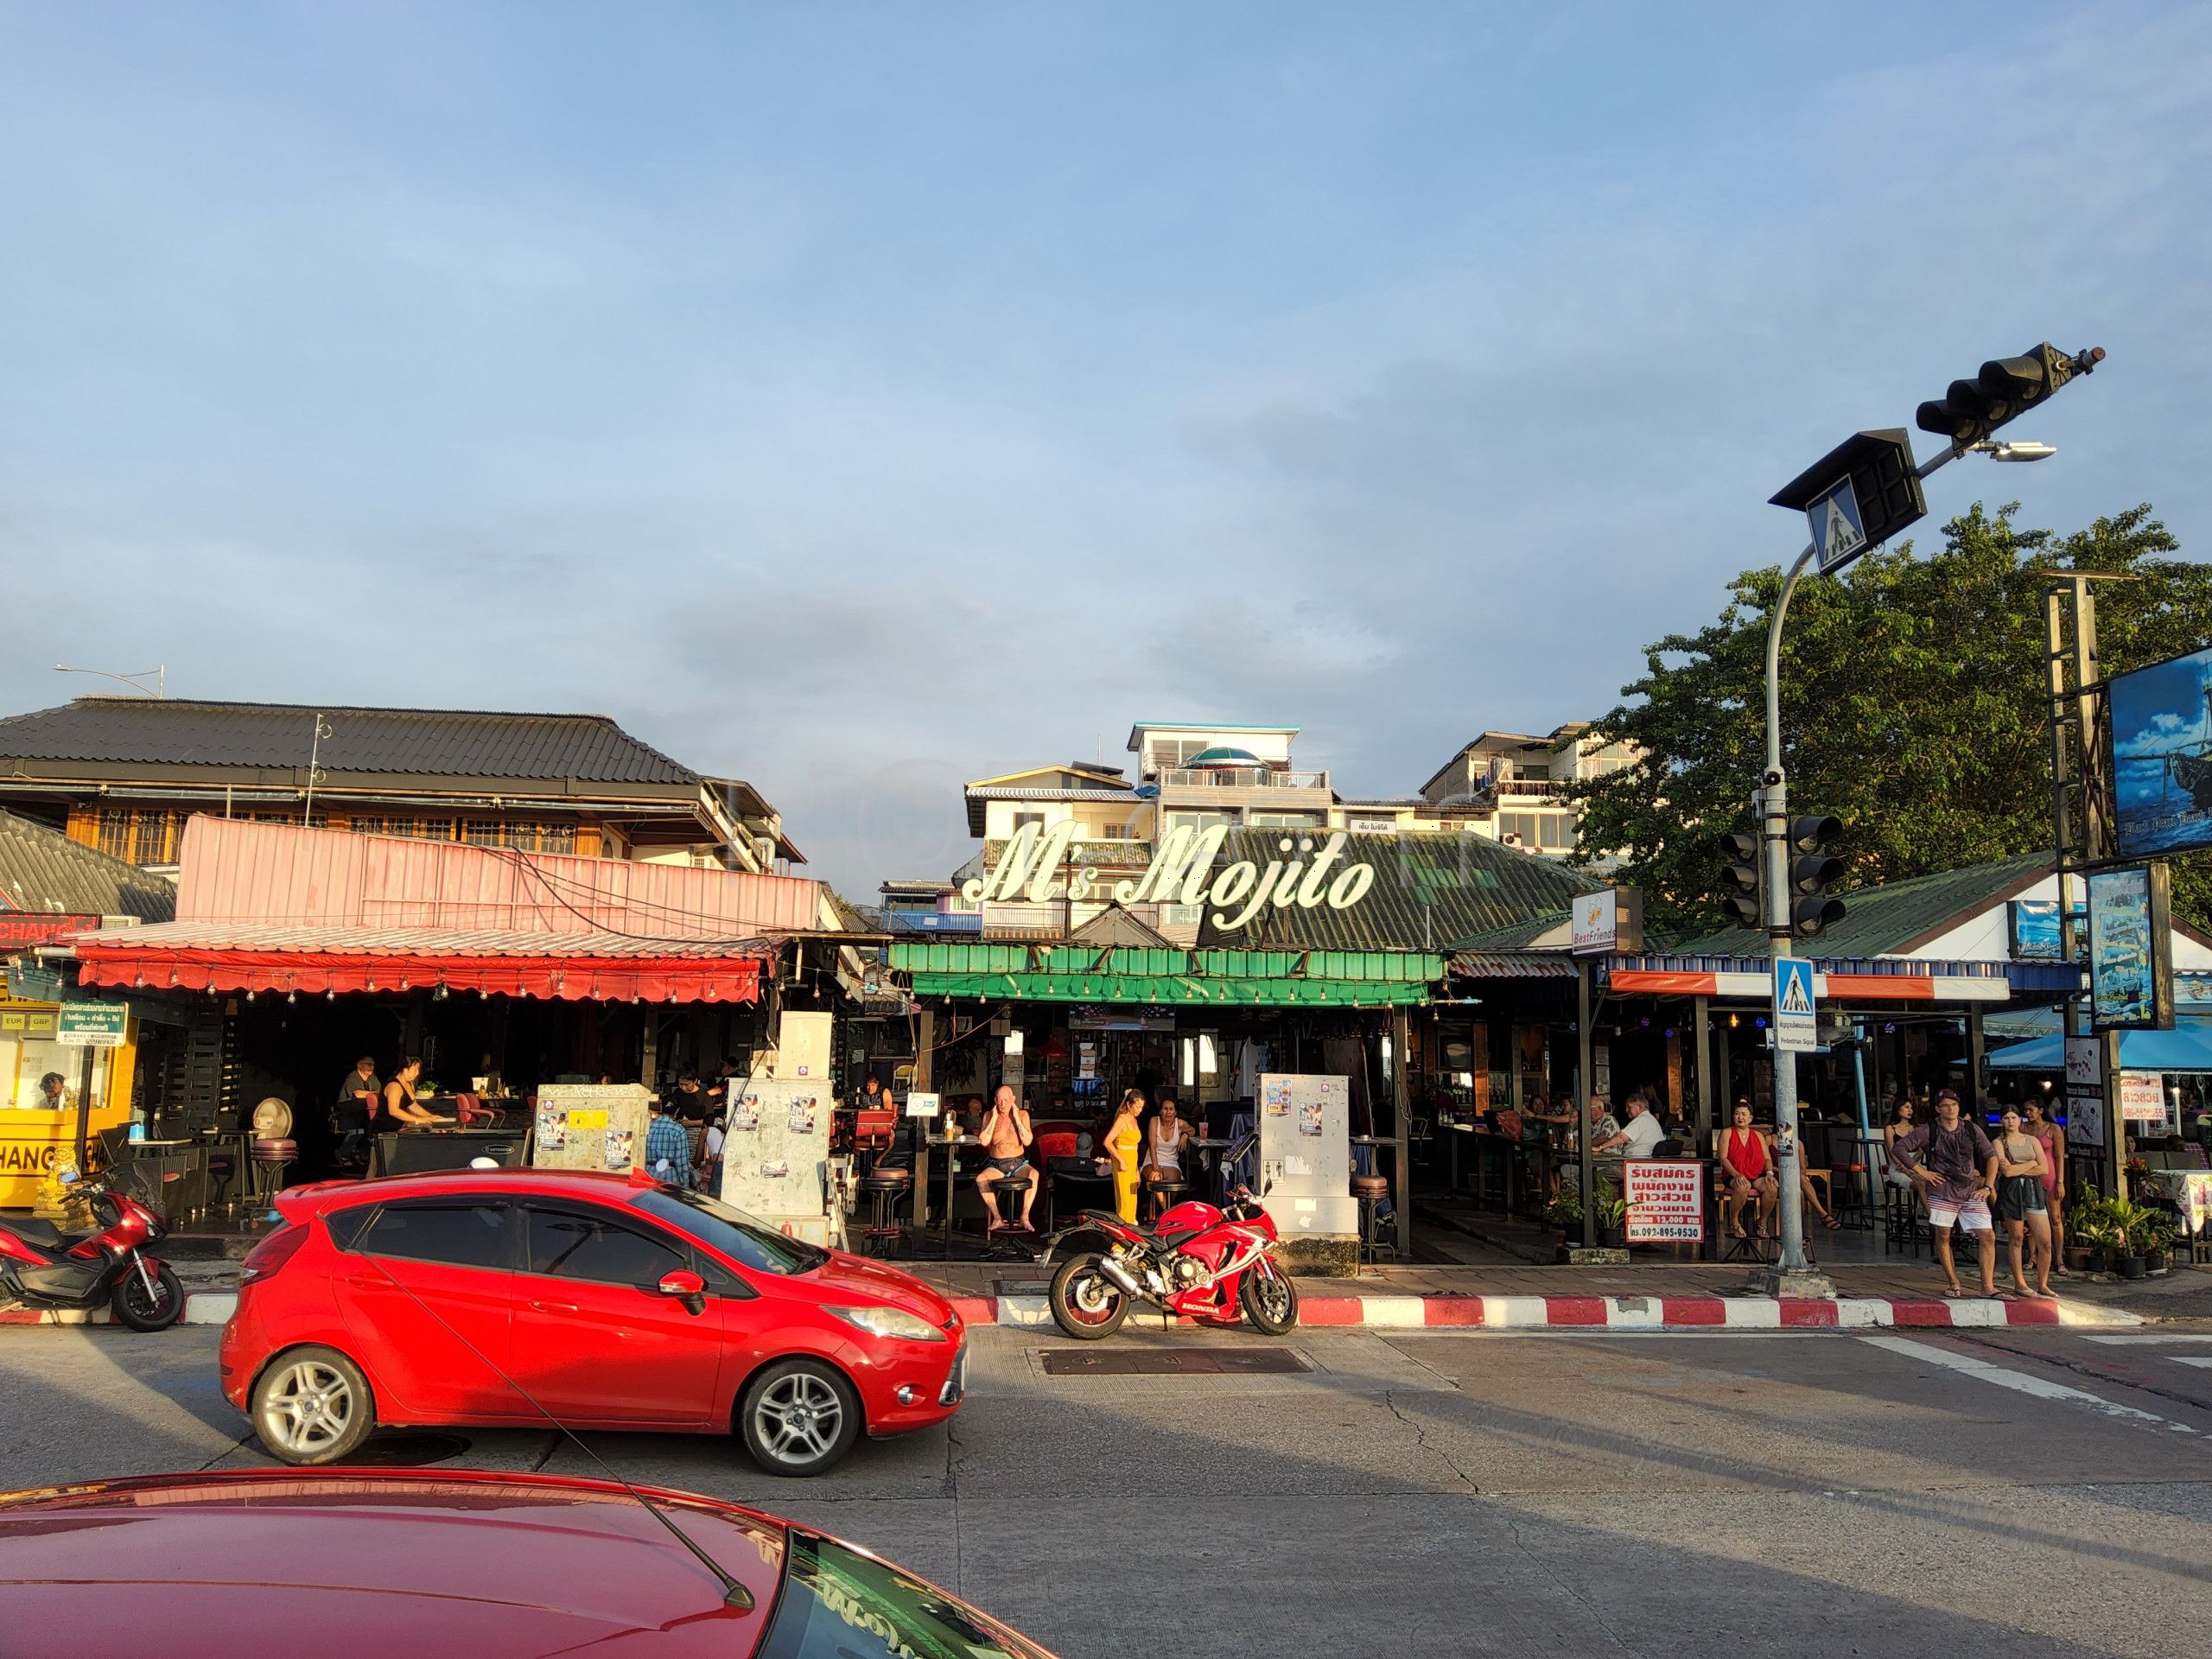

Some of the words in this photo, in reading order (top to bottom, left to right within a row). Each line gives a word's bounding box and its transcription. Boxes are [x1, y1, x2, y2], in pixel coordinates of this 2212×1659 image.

[962, 818, 1098, 903] M's
[1115, 823, 1374, 931] Mojito
[1573, 927, 1616, 944] BestFriends
[1630, 1165, 1695, 1179] รับสมัคร
[1631, 1179, 1694, 1192] พนักงาน
[1634, 1192, 1693, 1202] สาวสวย
[1656, 1216, 1684, 1224] 12,000
[1181, 1302, 1219, 1314] HONDA
